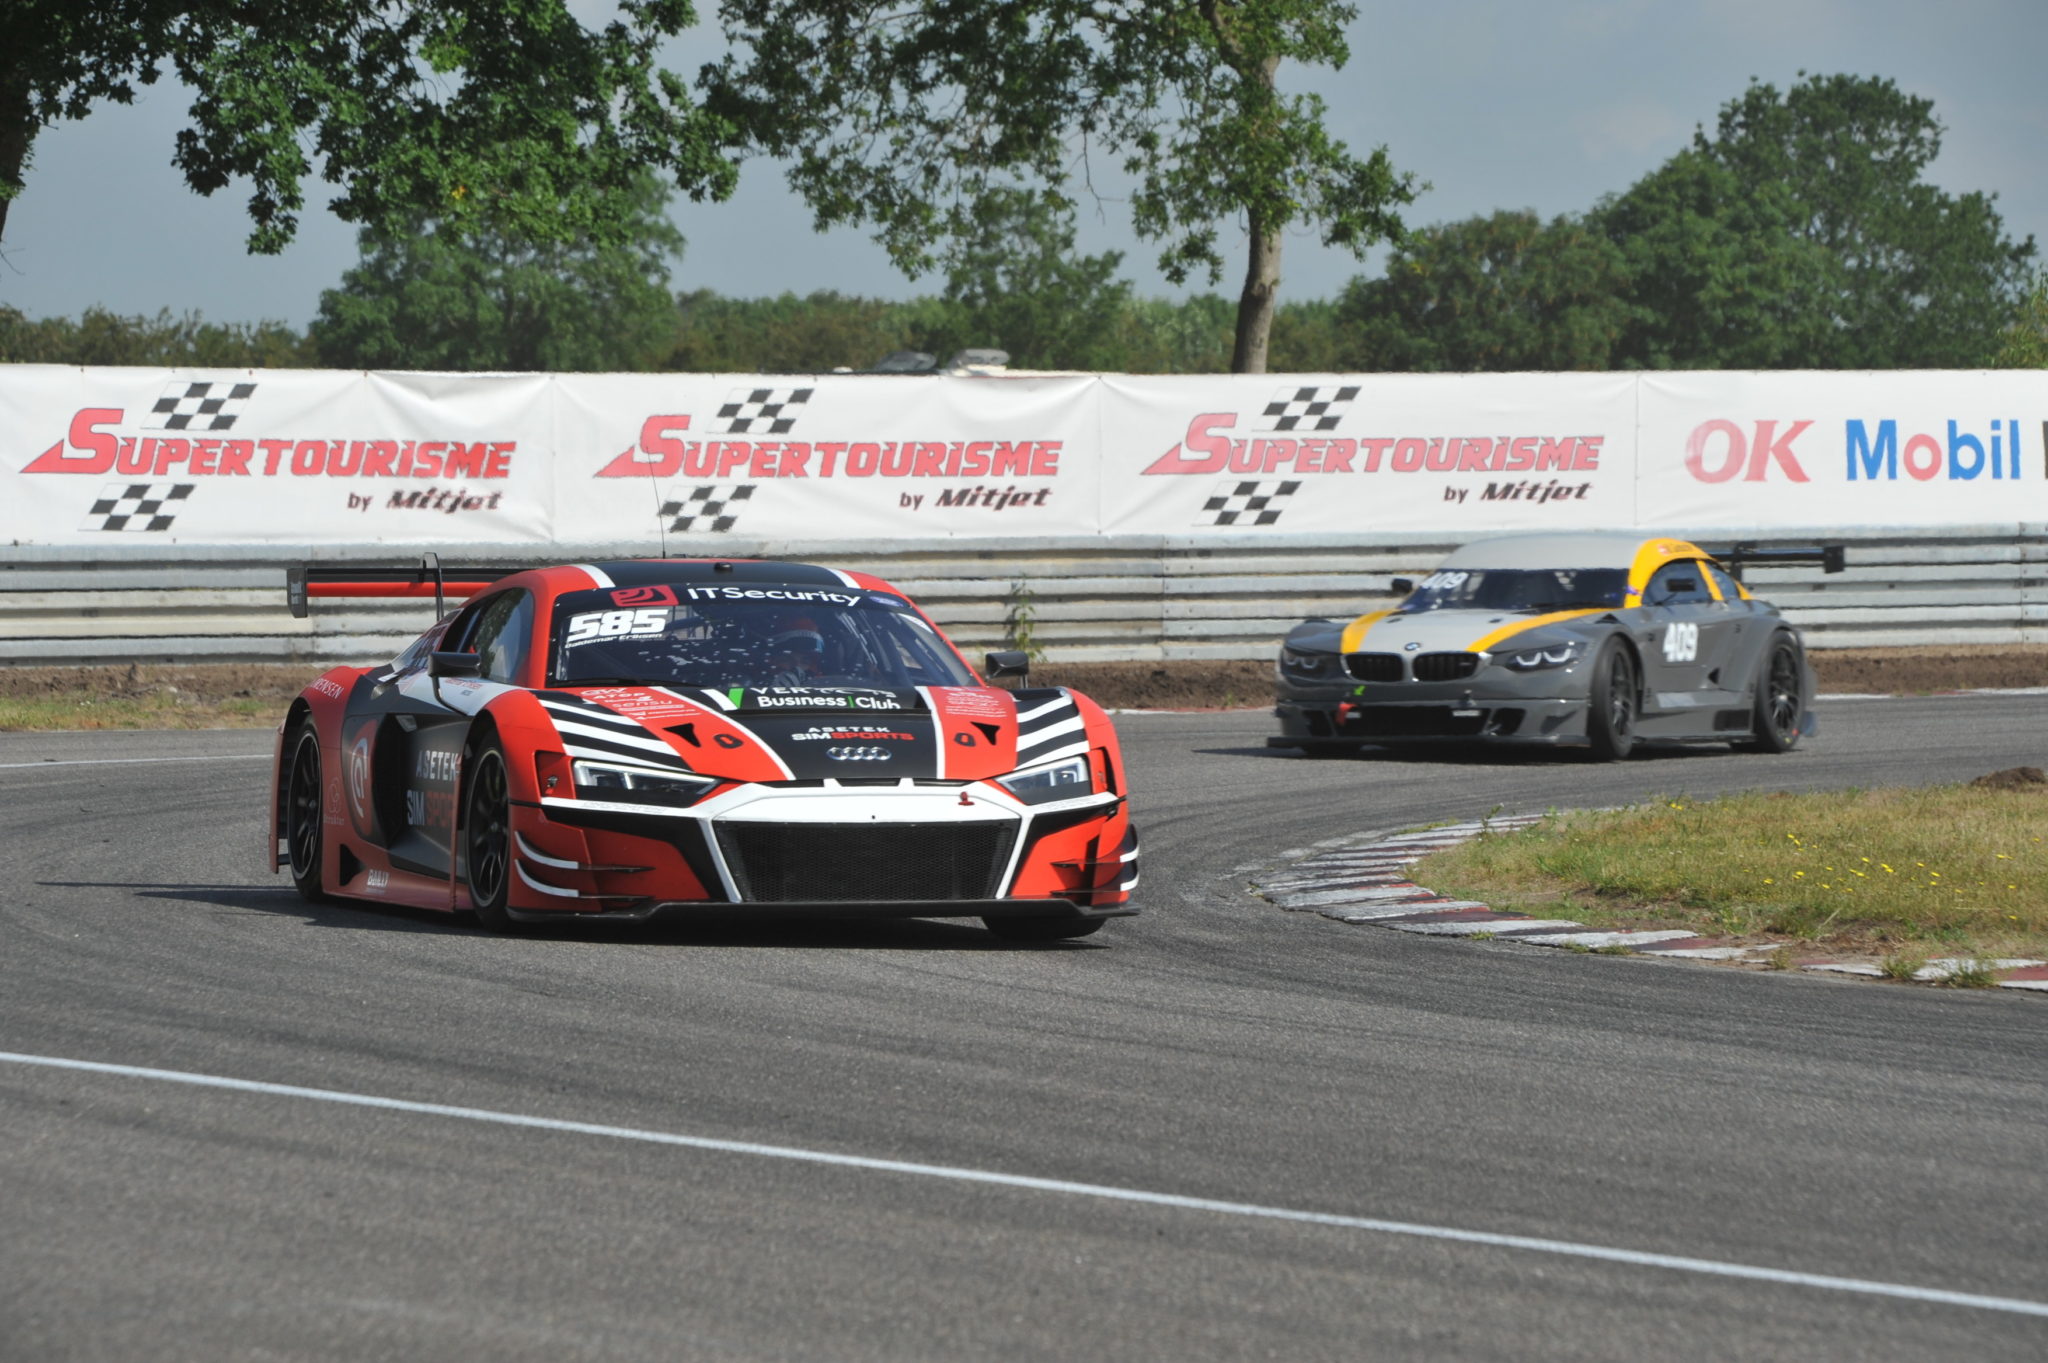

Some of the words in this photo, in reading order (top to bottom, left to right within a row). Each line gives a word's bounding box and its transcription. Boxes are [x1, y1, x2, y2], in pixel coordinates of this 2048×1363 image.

[19, 407, 518, 479] SUPERTOURISME
[593, 414, 1064, 478] SUPERTOURISME
[1140, 412, 1605, 476] SUPERTOURISME
[1684, 418, 1816, 485] OK
[1844, 418, 2022, 482] Mobil
[347, 491, 373, 513] by
[385, 485, 504, 515] Mitjet
[899, 491, 925, 512] by
[934, 484, 1054, 512] Mitjet
[1443, 485, 1470, 505] by
[1479, 478, 1594, 505] Mitjet
[566, 608, 670, 643] 585
[1662, 621, 1700, 663] 409
[756, 695, 848, 708] Business
